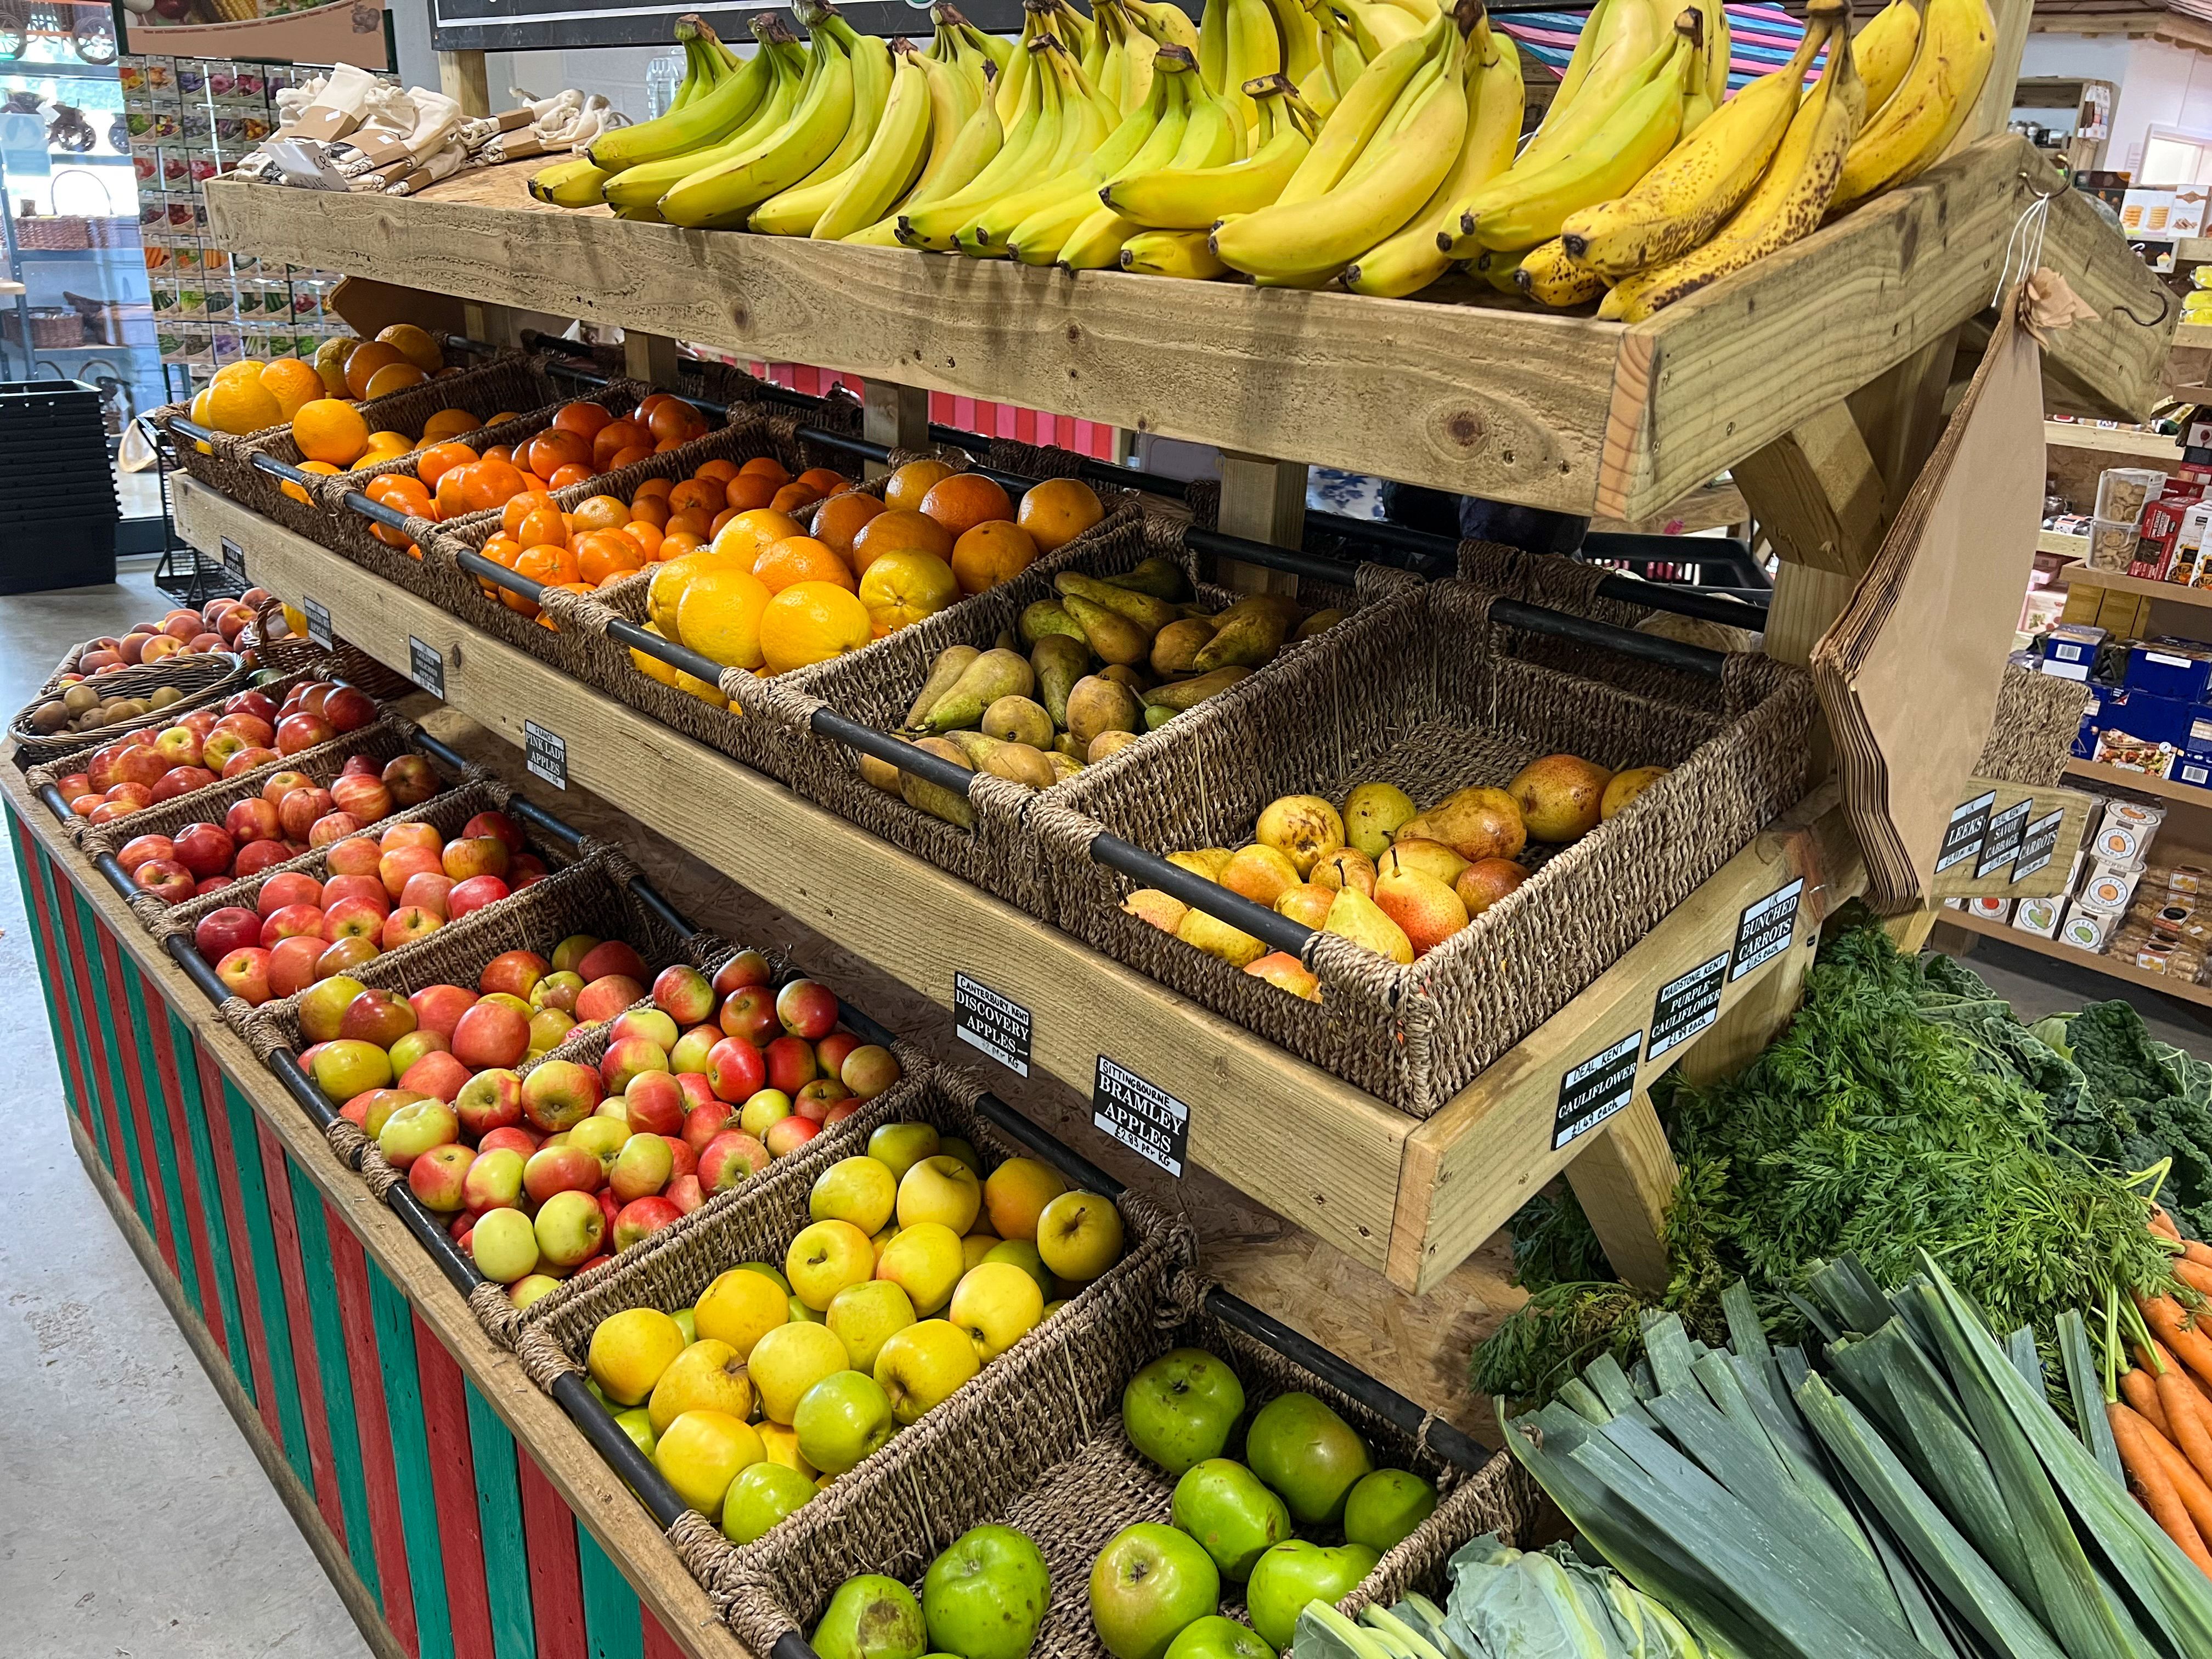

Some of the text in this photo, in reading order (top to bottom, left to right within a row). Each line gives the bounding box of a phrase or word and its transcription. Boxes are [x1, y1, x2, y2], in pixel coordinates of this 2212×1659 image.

[416, 657, 438, 678] DELICIOUS
[419, 669, 435, 685] APPLES
[526, 732, 565, 763] PINK LADY
[531, 750, 560, 776] APPLES
[2008, 804, 2023, 819] KENT
[1946, 815, 1984, 847] LEEKS
[1994, 816, 2019, 840] SAVOY
[1985, 832, 2019, 859] CABBAGE
[2019, 829, 2058, 861] CARROTS
[1768, 893, 1780, 909] UK
[1741, 896, 1797, 941] BUNCHED
[1739, 918, 1792, 961] CARROTS
[1763, 942, 1779, 958] each
[1703, 957, 1724, 976] KENT
[1670, 980, 1711, 1013] PURPLE
[956, 989, 1029, 1042] DISCOVERY
[1011, 1005, 1028, 1024] KENT
[1651, 988, 1721, 1038] CAULIFLOWER
[1688, 1015, 1707, 1033] each
[967, 1015, 1016, 1053] APPLES
[992, 1046, 1006, 1059] per
[1008, 1053, 1019, 1069] KG
[1601, 1040, 1625, 1065] KENT
[1102, 1060, 1171, 1109] SITTINGBOURNE
[1559, 1062, 1637, 1119] CAULIFLOWER
[1099, 1073, 1183, 1136] BRAMLEY
[1598, 1098, 1618, 1119] each
[1104, 1102, 1171, 1153] APPLES
[1141, 1142, 1155, 1155] per
[1158, 1151, 1171, 1167] KG
